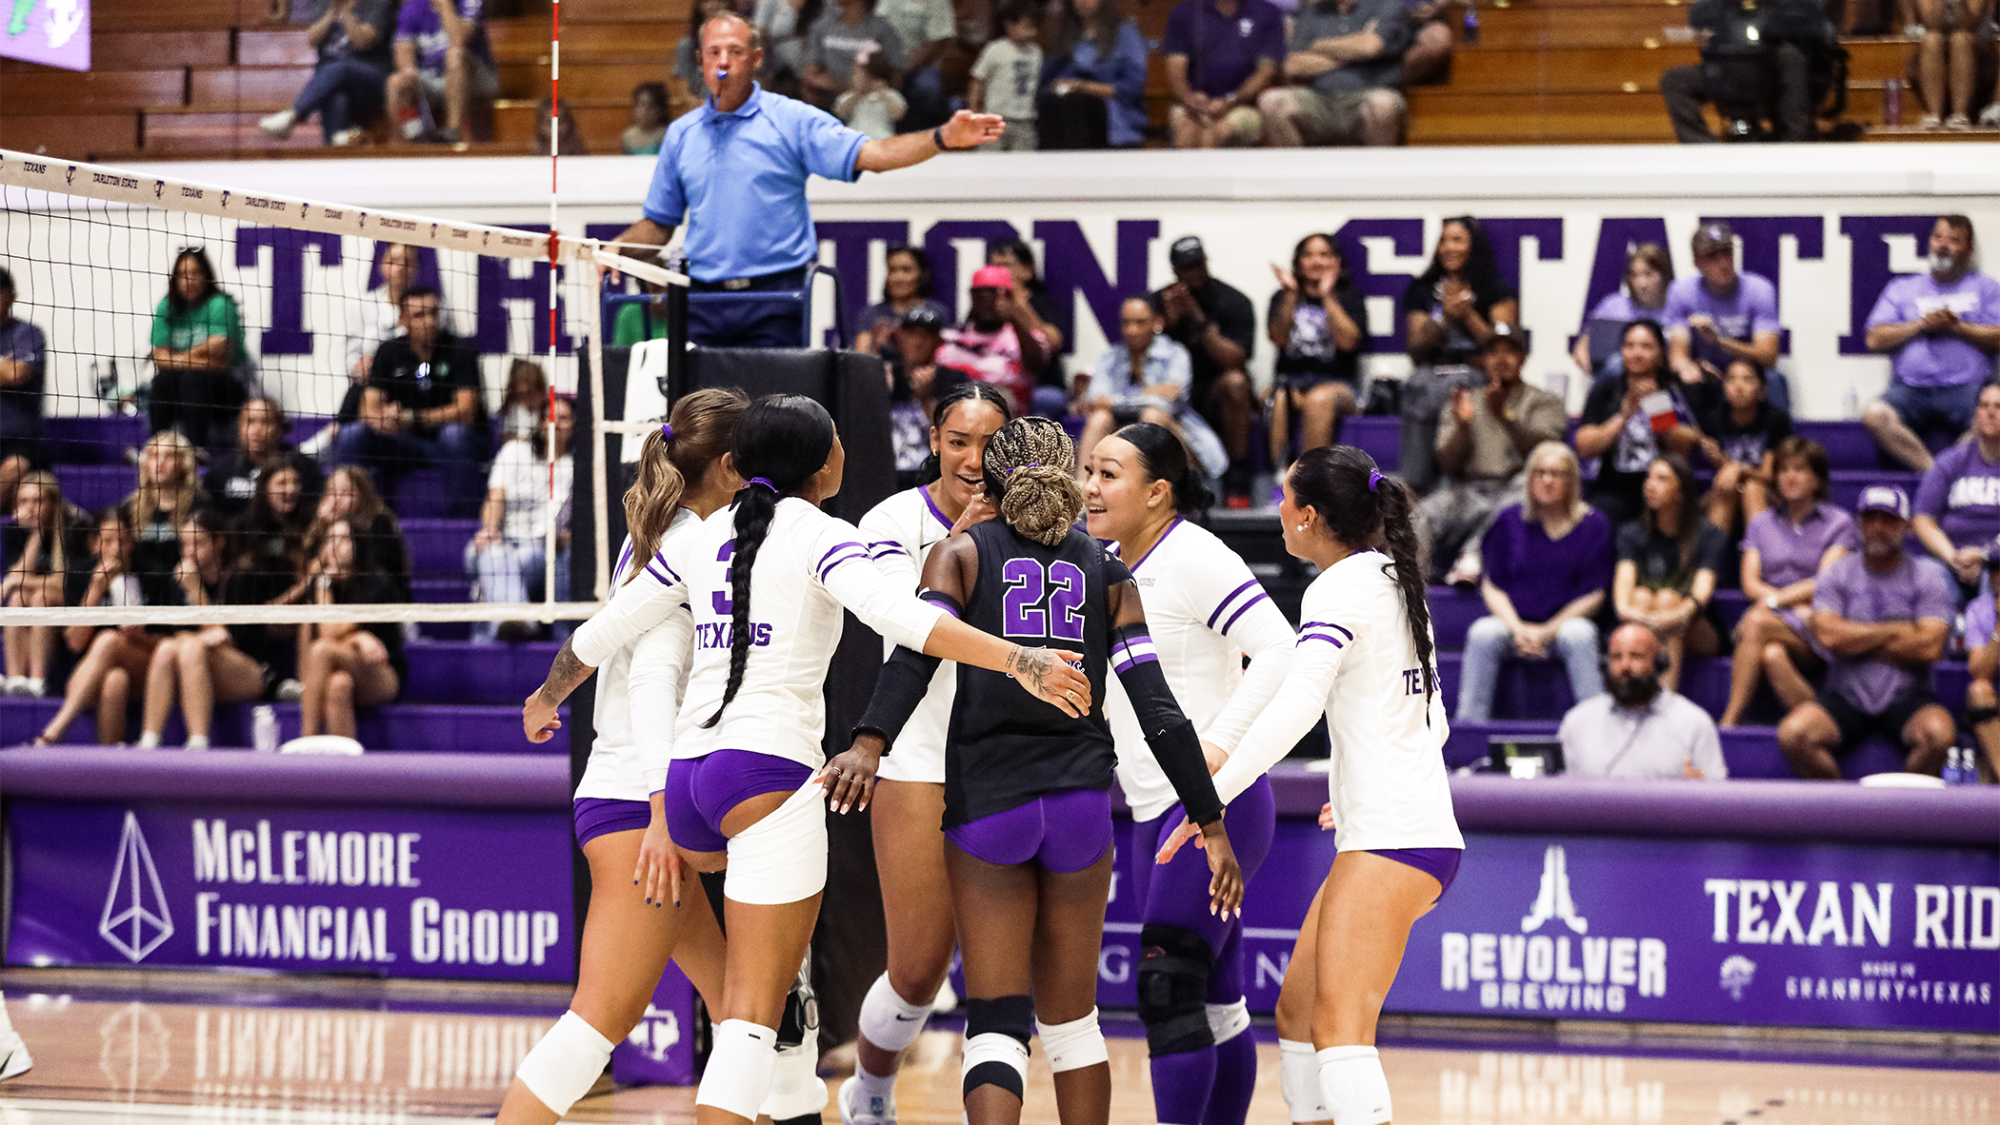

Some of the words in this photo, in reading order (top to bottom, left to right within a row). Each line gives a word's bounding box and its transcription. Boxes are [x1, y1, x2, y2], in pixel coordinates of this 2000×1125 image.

[24, 161, 46, 174] TEXANS
[93, 173, 120, 187] TARLETON
[121, 177, 138, 189] STATE
[181, 187, 203, 199] TEXANS
[270, 200, 286, 211] STATE
[712, 538, 737, 615] 3
[1003, 558, 1085, 643] 22
[196, 891, 397, 961] FINANCIAL
[410, 897, 559, 966] GROUP
[1704, 880, 1893, 947] TEXAN
[1913, 884, 2000, 949] RID
[1441, 932, 1667, 997] REVOLVER
[1480, 981, 1626, 1012] BREWING
[1786, 976, 1905, 1002] GRANBURY
[1921, 980, 1992, 1005] TEXAS
